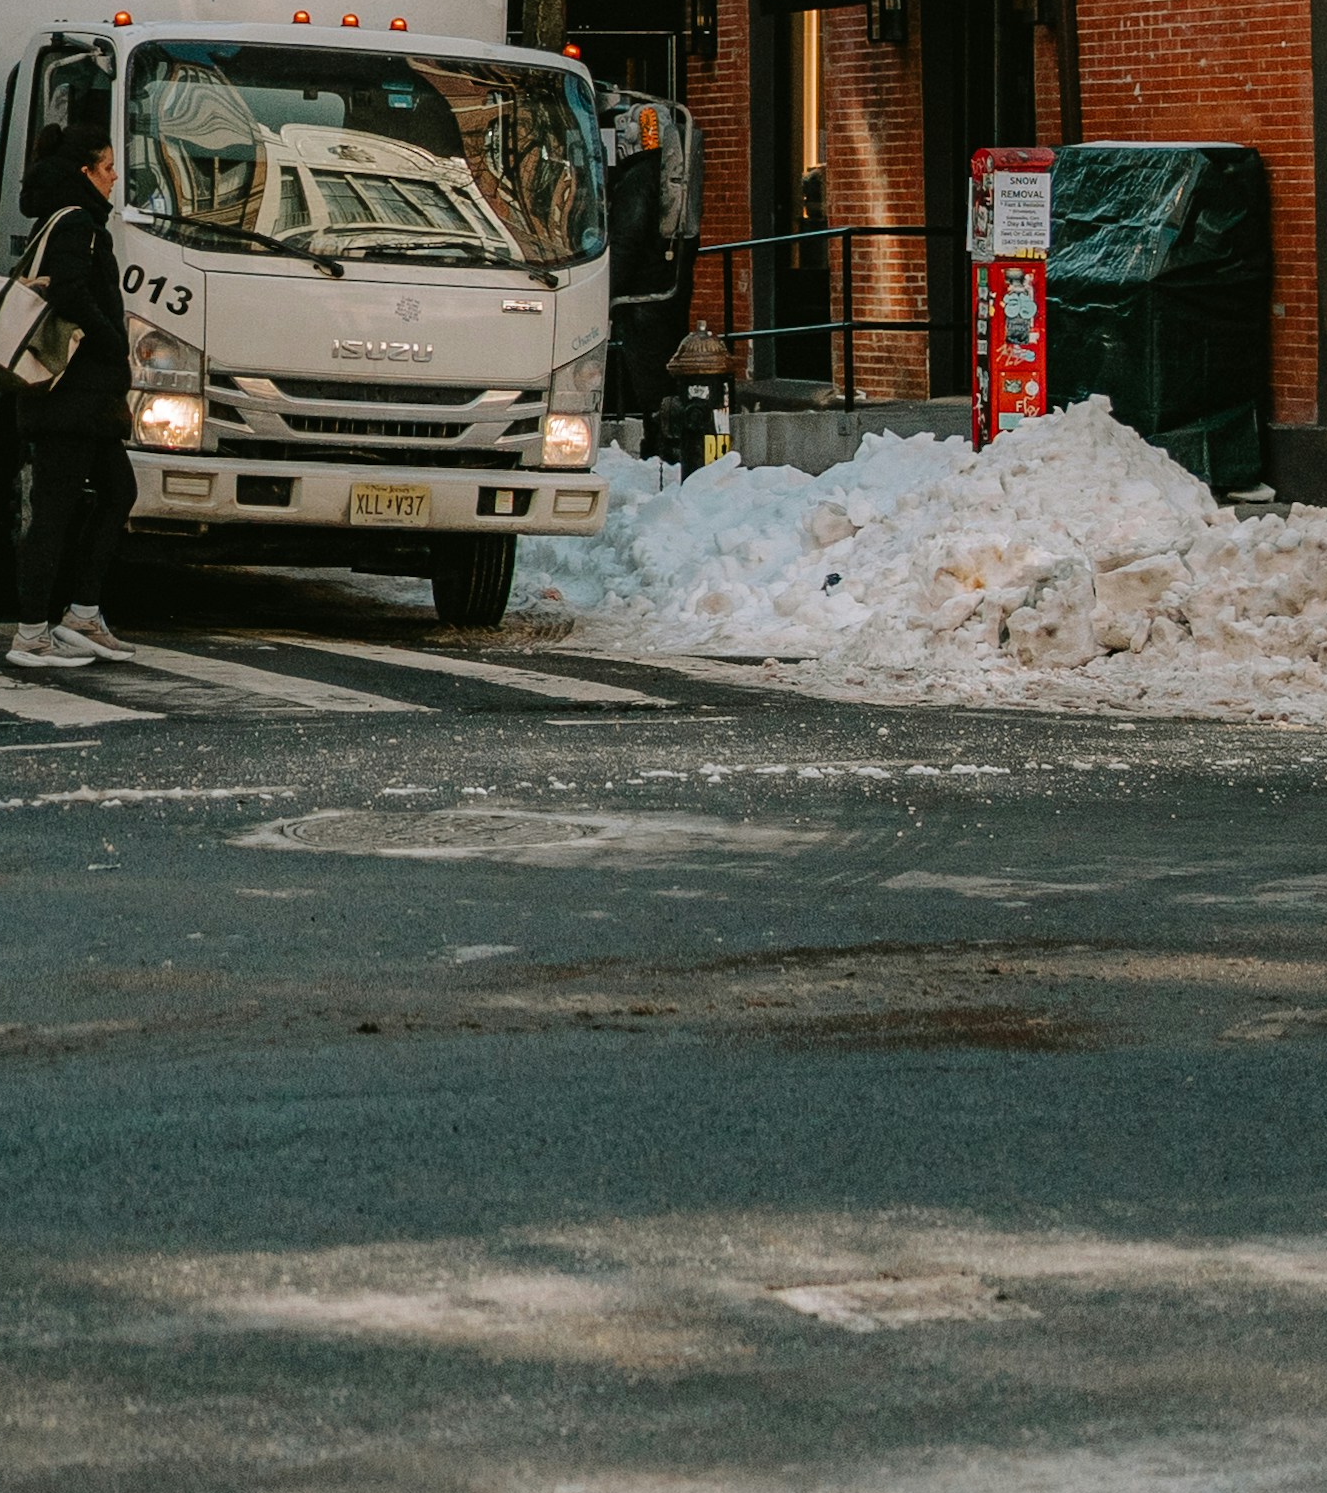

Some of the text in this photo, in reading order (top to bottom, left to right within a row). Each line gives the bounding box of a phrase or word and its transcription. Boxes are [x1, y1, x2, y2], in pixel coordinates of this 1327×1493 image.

[1009, 177, 1038, 185] SNOW
[1000, 190, 1045, 198] REMOVAL
[123, 264, 193, 316] 013
[332, 339, 434, 363] ISUZU
[356, 493, 425, 516] XLL V37
